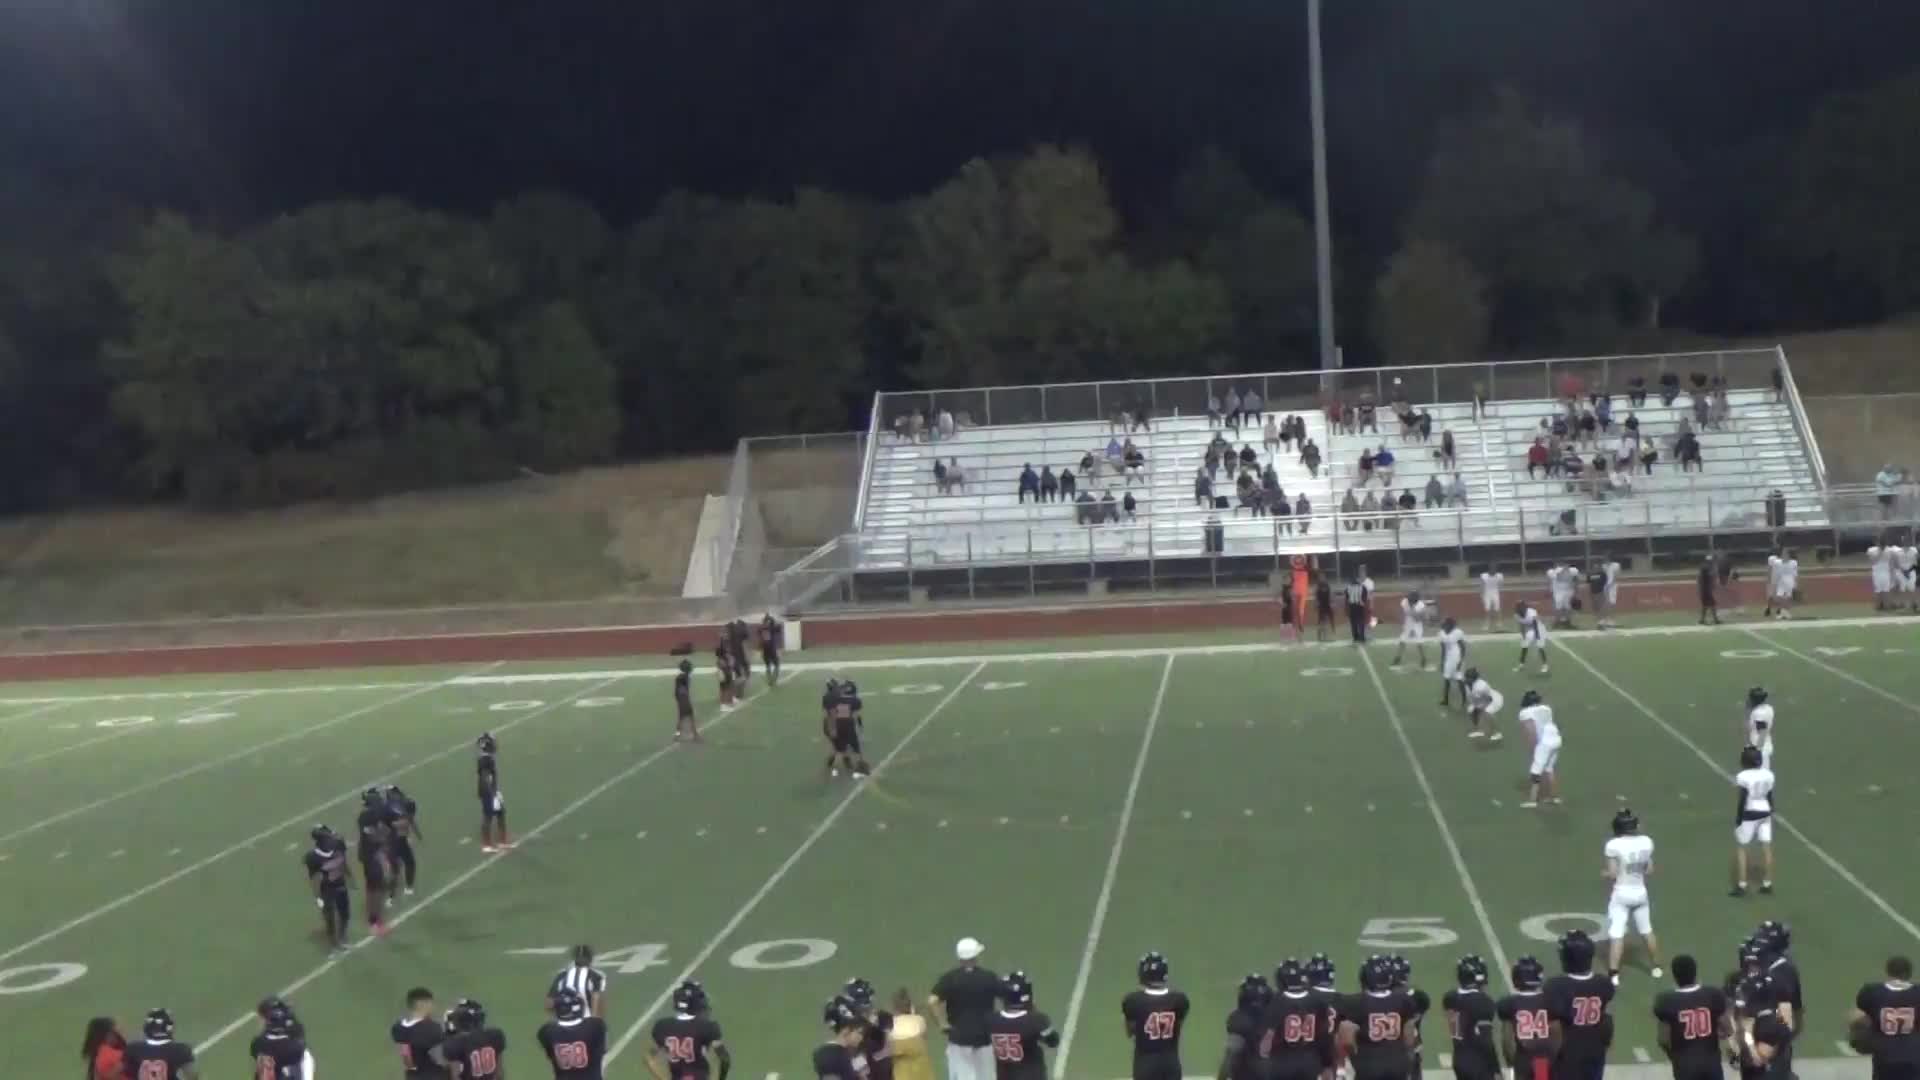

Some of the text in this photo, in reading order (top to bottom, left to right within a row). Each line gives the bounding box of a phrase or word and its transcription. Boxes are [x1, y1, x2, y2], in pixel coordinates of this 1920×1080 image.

[1144, 1011, 1176, 1040] 47
[1284, 1014, 1316, 1042] 64
[1516, 1010, 1549, 1041] 24
[1679, 1008, 1711, 1040] 70
